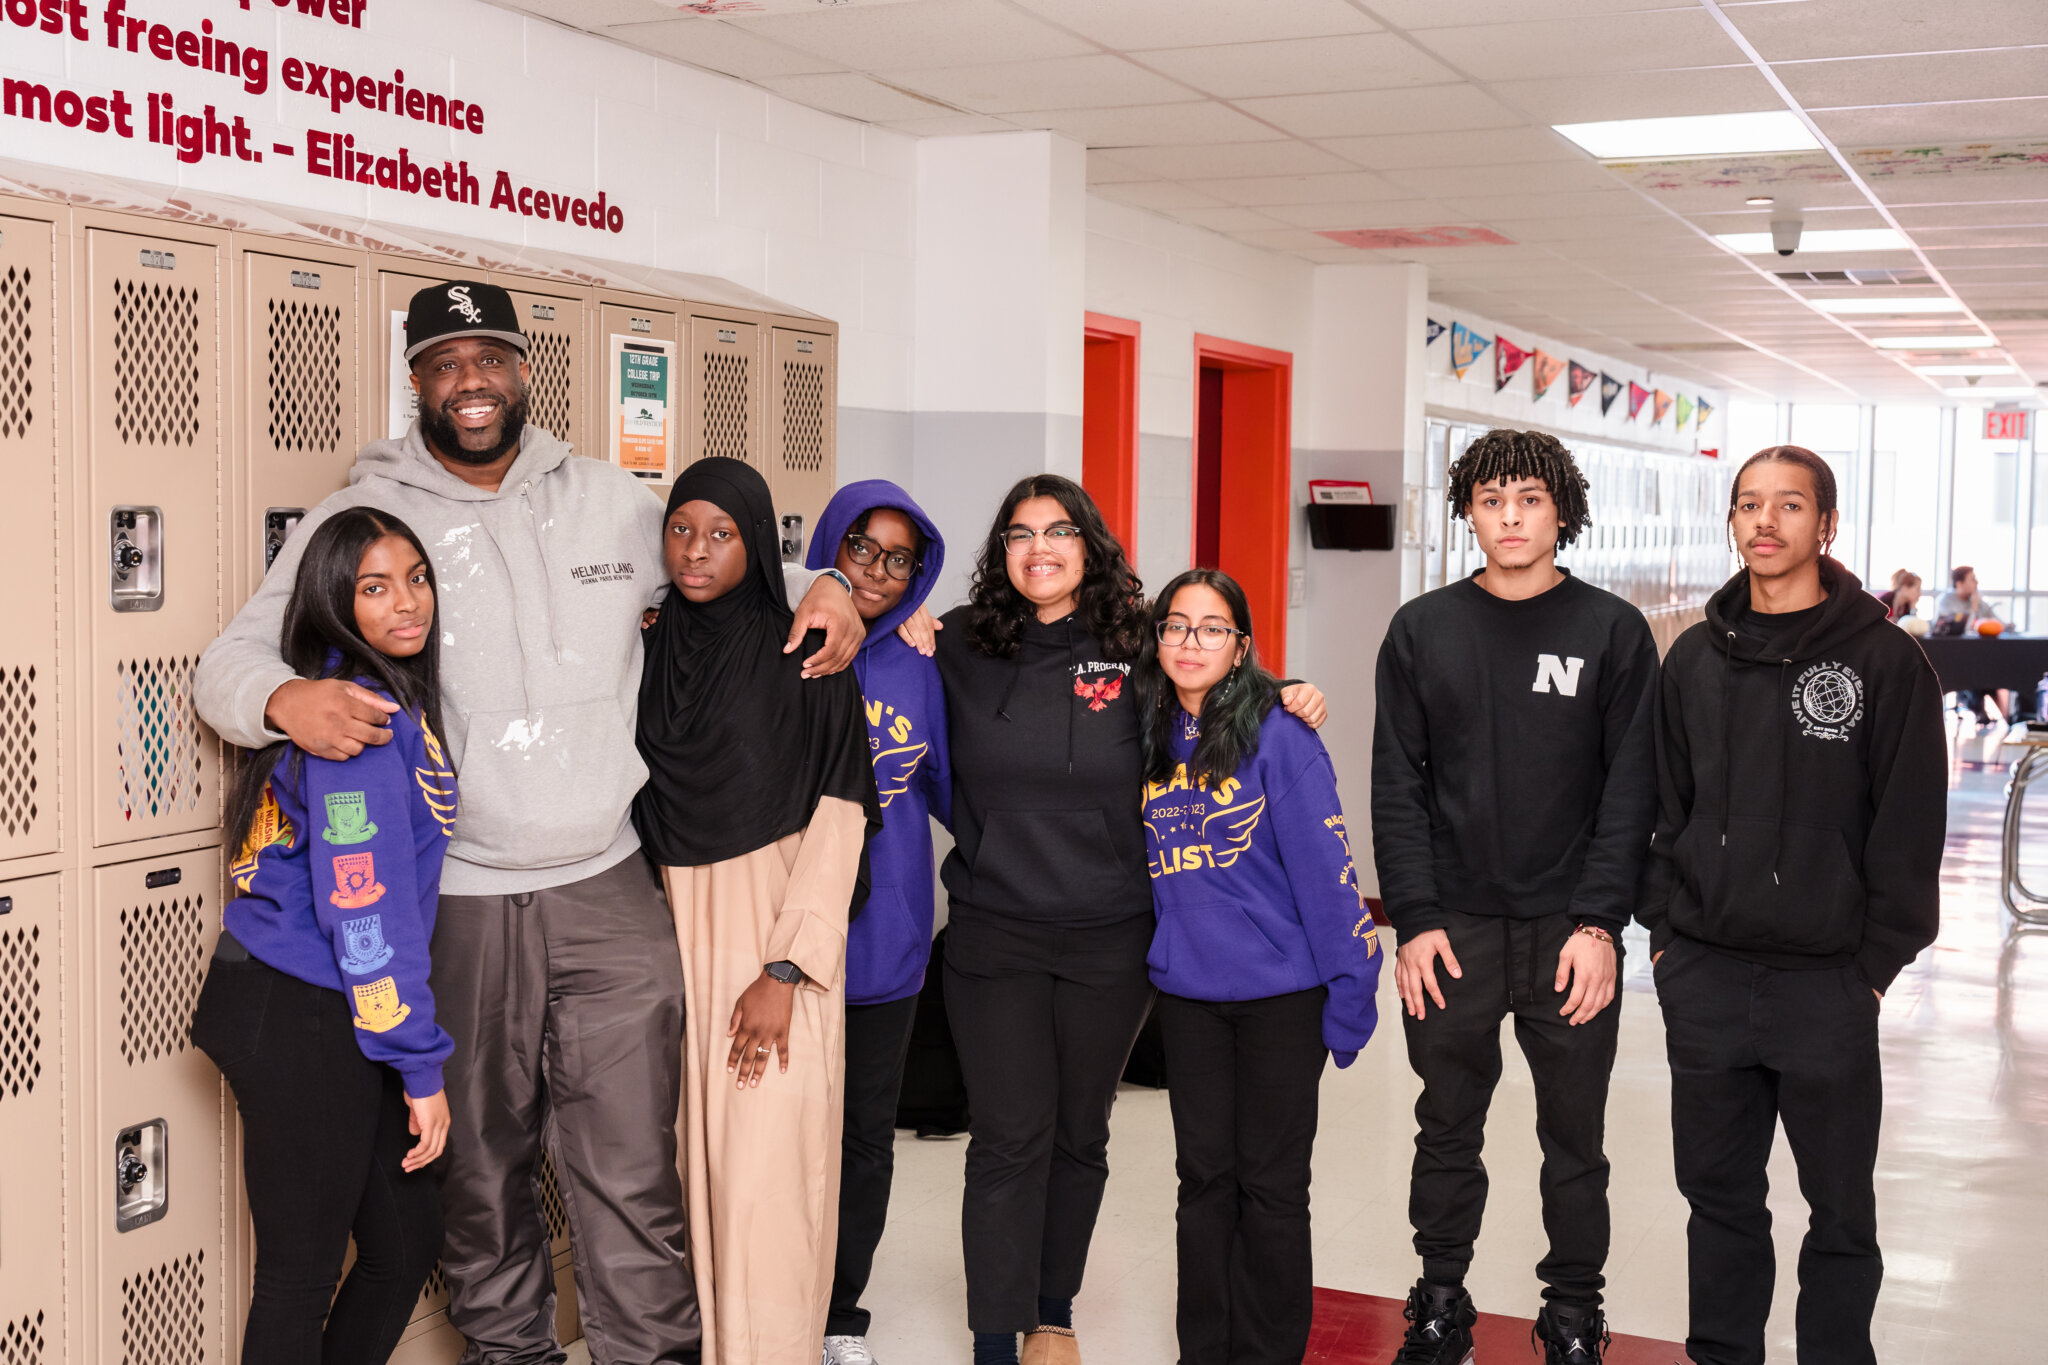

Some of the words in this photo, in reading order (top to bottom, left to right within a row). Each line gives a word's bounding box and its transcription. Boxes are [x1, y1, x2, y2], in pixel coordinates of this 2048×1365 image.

[240, 0, 367, 29] wer
[0, 0, 89, 41] ost
[104, 0, 268, 95] freeing
[282, 57, 484, 134] experience
[3, 78, 133, 138] most
[148, 93, 262, 163] light.
[306, 129, 480, 206] Elizabeth
[489, 170, 624, 234] Acevedo
[629, 353, 641, 365] 12TH
[641, 355, 659, 367] GRADE
[627, 368, 648, 381] COLLEGE
[649, 371, 661, 382] TRIP
[1987, 411, 2027, 439] EXIT
[571, 563, 610, 579] HELMUT
[612, 562, 634, 574] LANG
[581, 577, 598, 585] VIENNA
[1532, 653, 1584, 697] N
[1797, 661, 1842, 685] FULLY
[1791, 684, 1802, 698] IT
[1791, 699, 1814, 730] LIVE
[264, 809, 274, 844] NUASIN
[1323, 814, 1344, 829] RIGO
[1159, 844, 1216, 875] LIST
